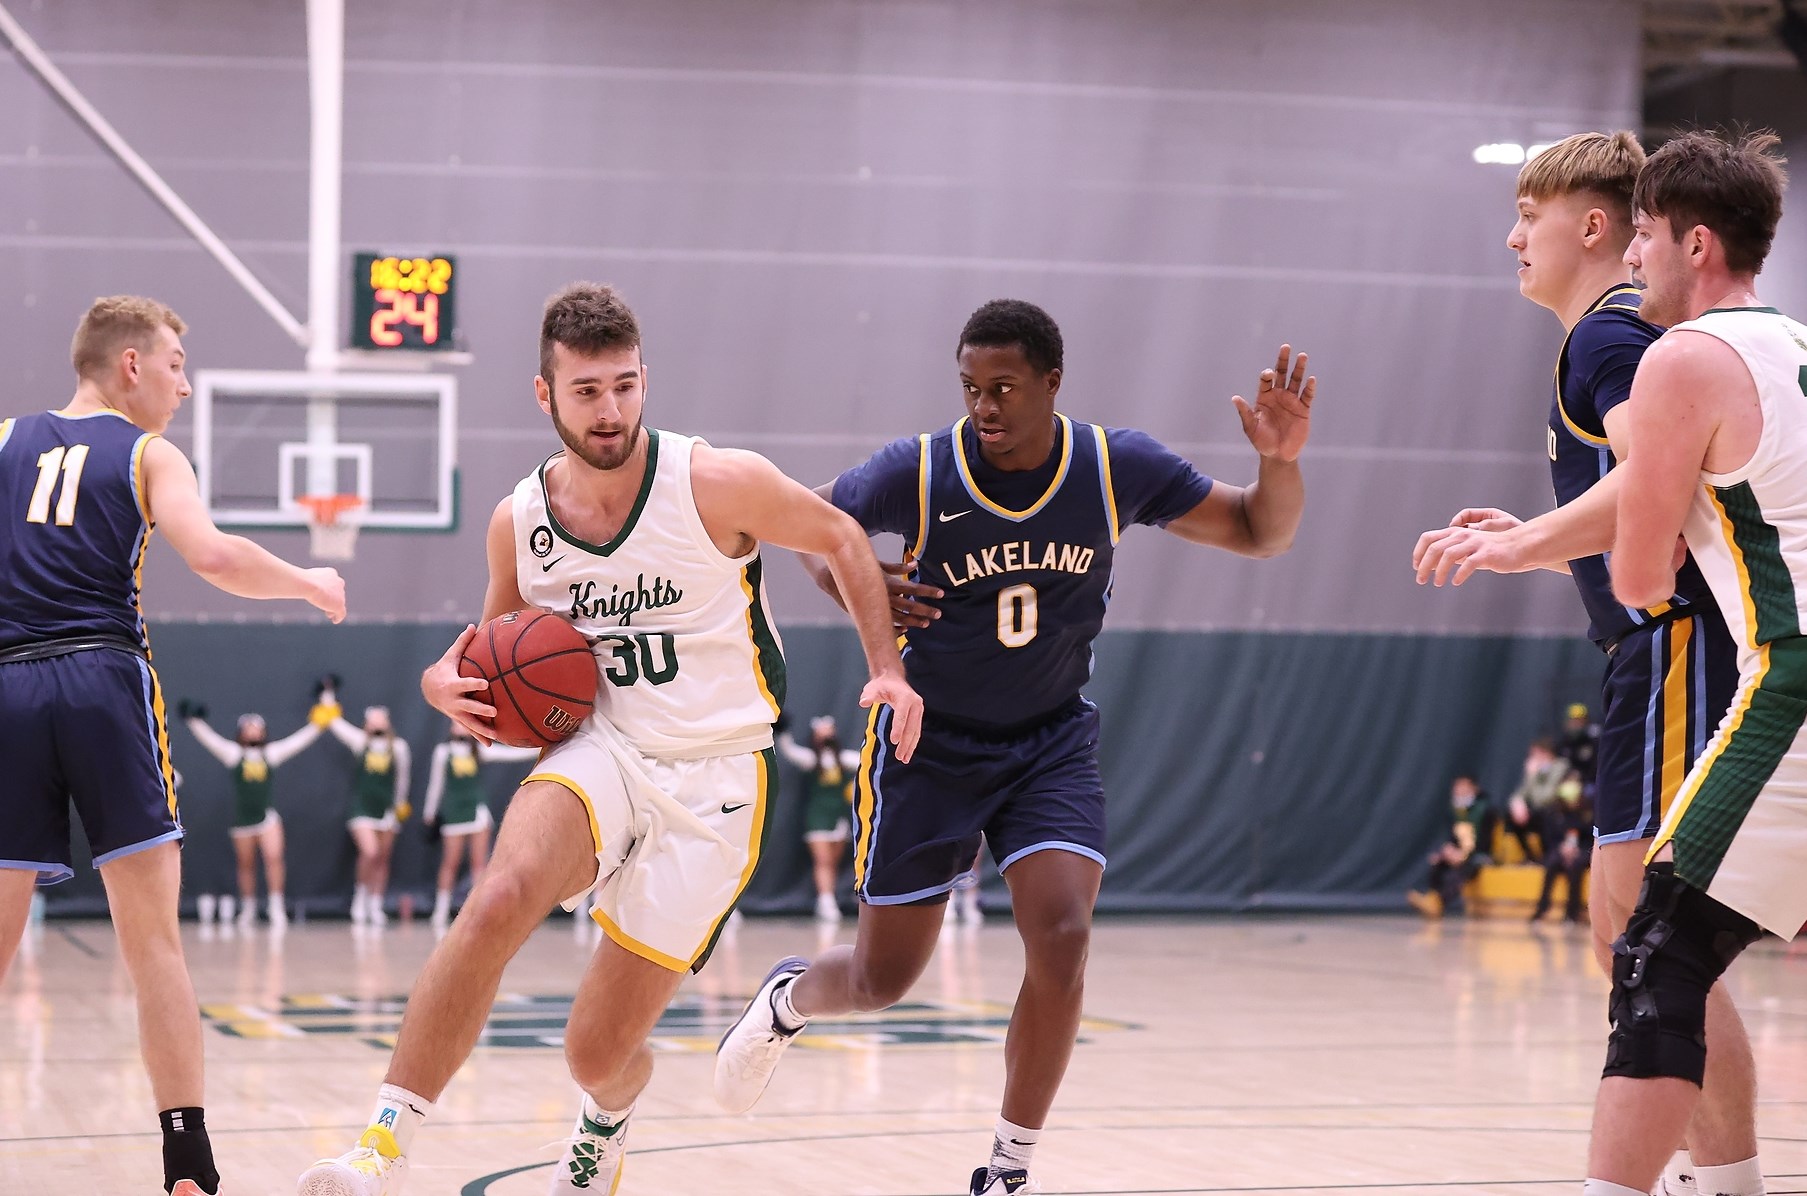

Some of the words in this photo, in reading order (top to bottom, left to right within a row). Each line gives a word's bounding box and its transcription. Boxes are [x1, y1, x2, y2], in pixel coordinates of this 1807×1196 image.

[371, 290, 438, 346] 24
[27, 444, 90, 526] 11
[942, 541, 1095, 587] LAKELAND
[569, 573, 683, 626] Knights
[997, 582, 1038, 648] 0
[597, 633, 680, 687] 30
